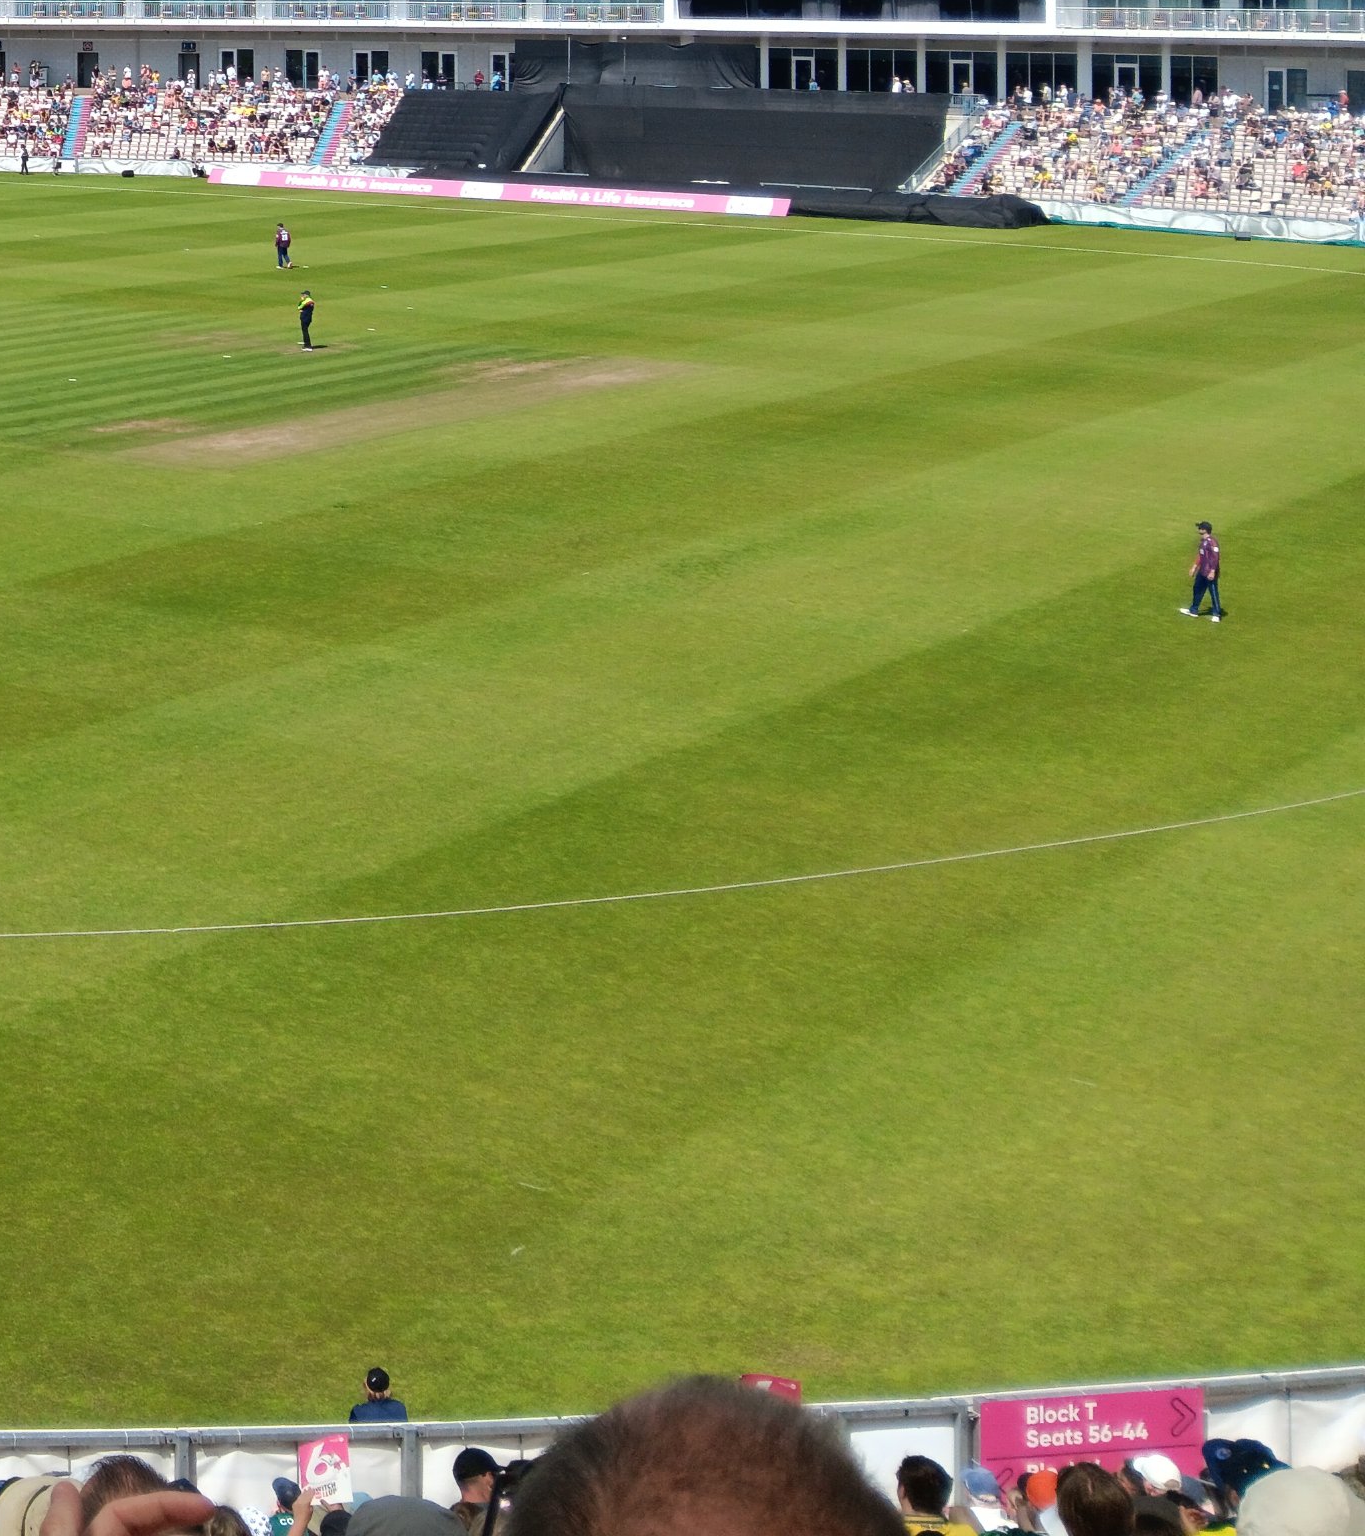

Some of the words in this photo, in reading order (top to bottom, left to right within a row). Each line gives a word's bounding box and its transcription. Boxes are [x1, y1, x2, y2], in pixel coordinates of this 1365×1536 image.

[285, 175, 327, 187] Health
[341, 177, 367, 189] Life
[531, 188, 577, 201] Health
[594, 191, 621, 205] Life
[1026, 1405, 1080, 1425] Block
[1084, 1402, 1098, 1420] T
[1026, 1428, 1083, 1448] Seats
[1088, 1422, 1148, 1444] 56-44
